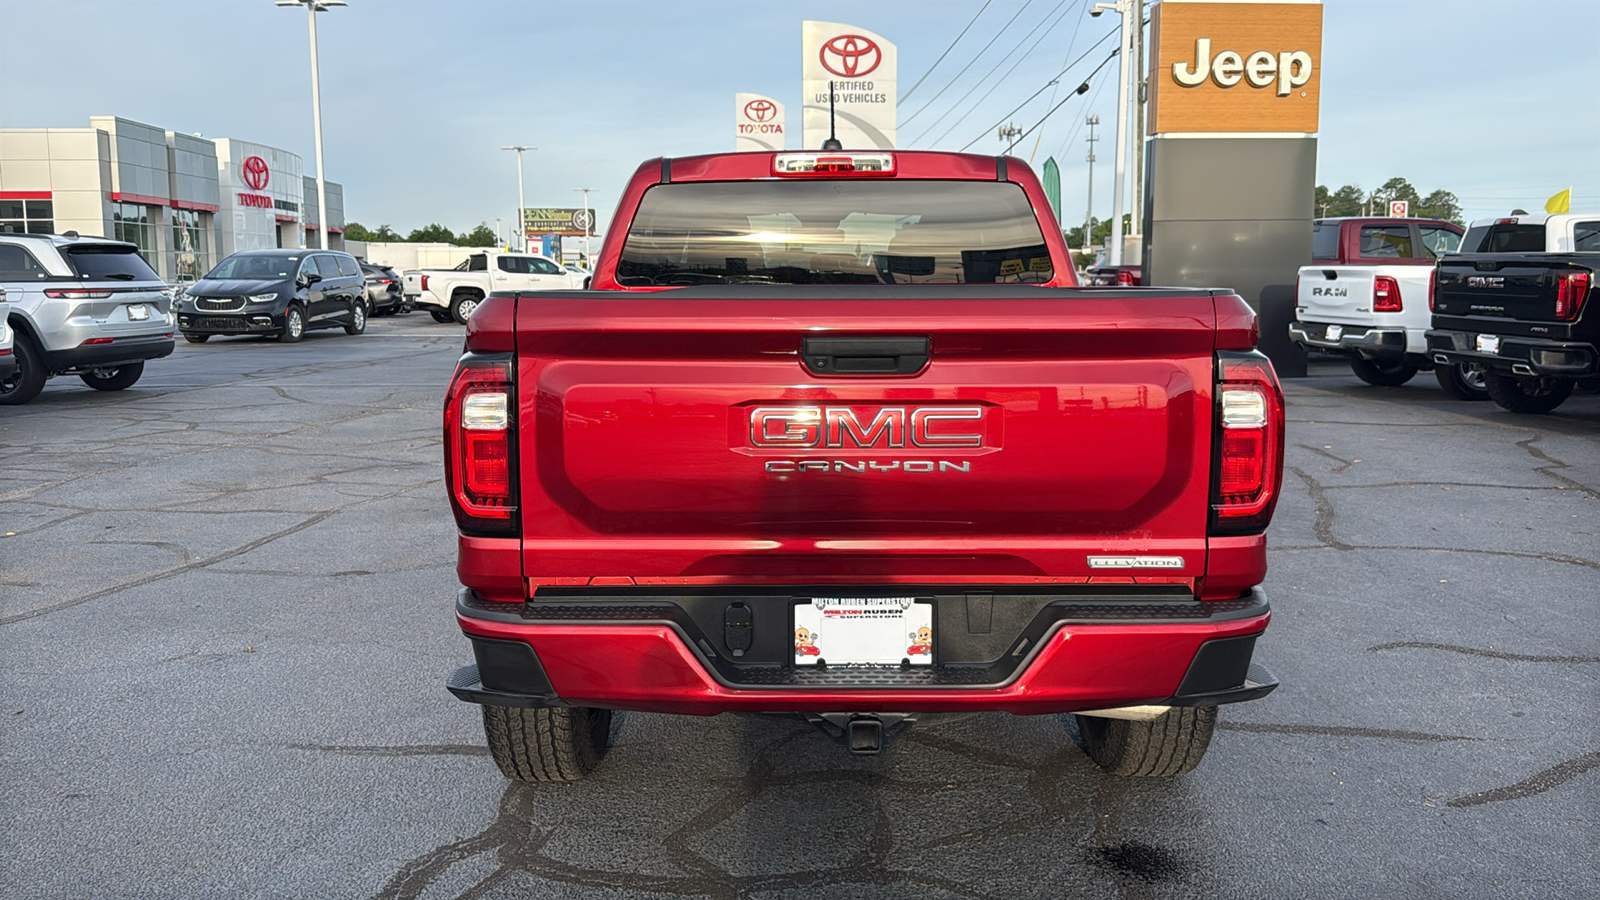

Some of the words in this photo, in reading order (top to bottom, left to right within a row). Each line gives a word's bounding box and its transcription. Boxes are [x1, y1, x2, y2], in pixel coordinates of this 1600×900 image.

[1172, 37, 1312, 97] Jeep
[843, 93, 886, 103] VEHICLES
[738, 124, 783, 134] TOYOTA
[239, 193, 273, 209] TOYOTA
[1467, 276, 1504, 288] GMC
[1312, 287, 1348, 297] RAM
[750, 407, 982, 448] GMC
[764, 460, 971, 473] CANYON
[812, 597, 839, 606] MILTON
[841, 597, 866, 606] RUBEN
[867, 597, 914, 606] SUPERSTORE
